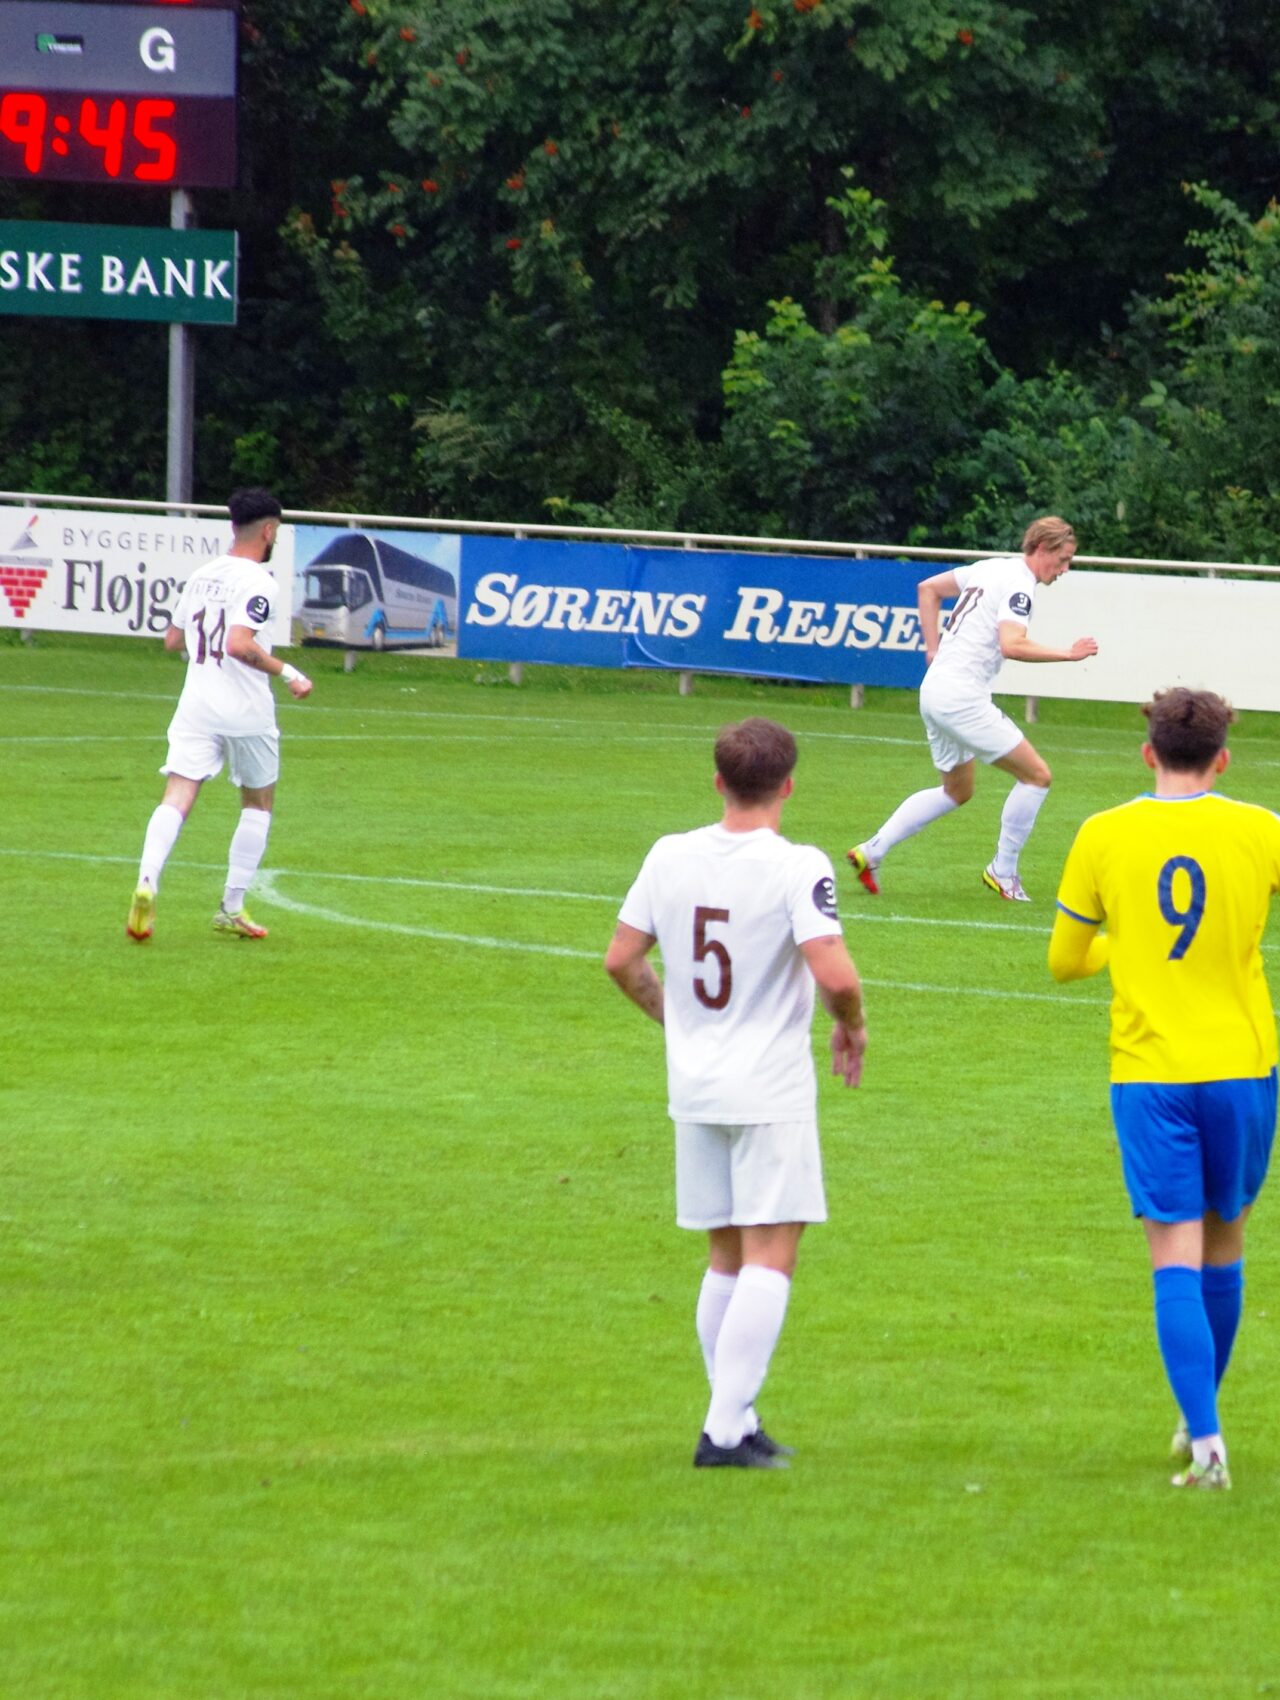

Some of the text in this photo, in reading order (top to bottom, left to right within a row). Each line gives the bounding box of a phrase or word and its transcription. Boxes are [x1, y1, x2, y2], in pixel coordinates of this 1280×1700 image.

[139, 27, 176, 72] G
[101, 255, 232, 299] BANK
[62, 527, 232, 556] BYGGEFIRM
[466, 572, 705, 639] SØRENS
[192, 606, 226, 668] 14
[1156, 855, 1206, 961] 9
[692, 906, 732, 1010] 5
